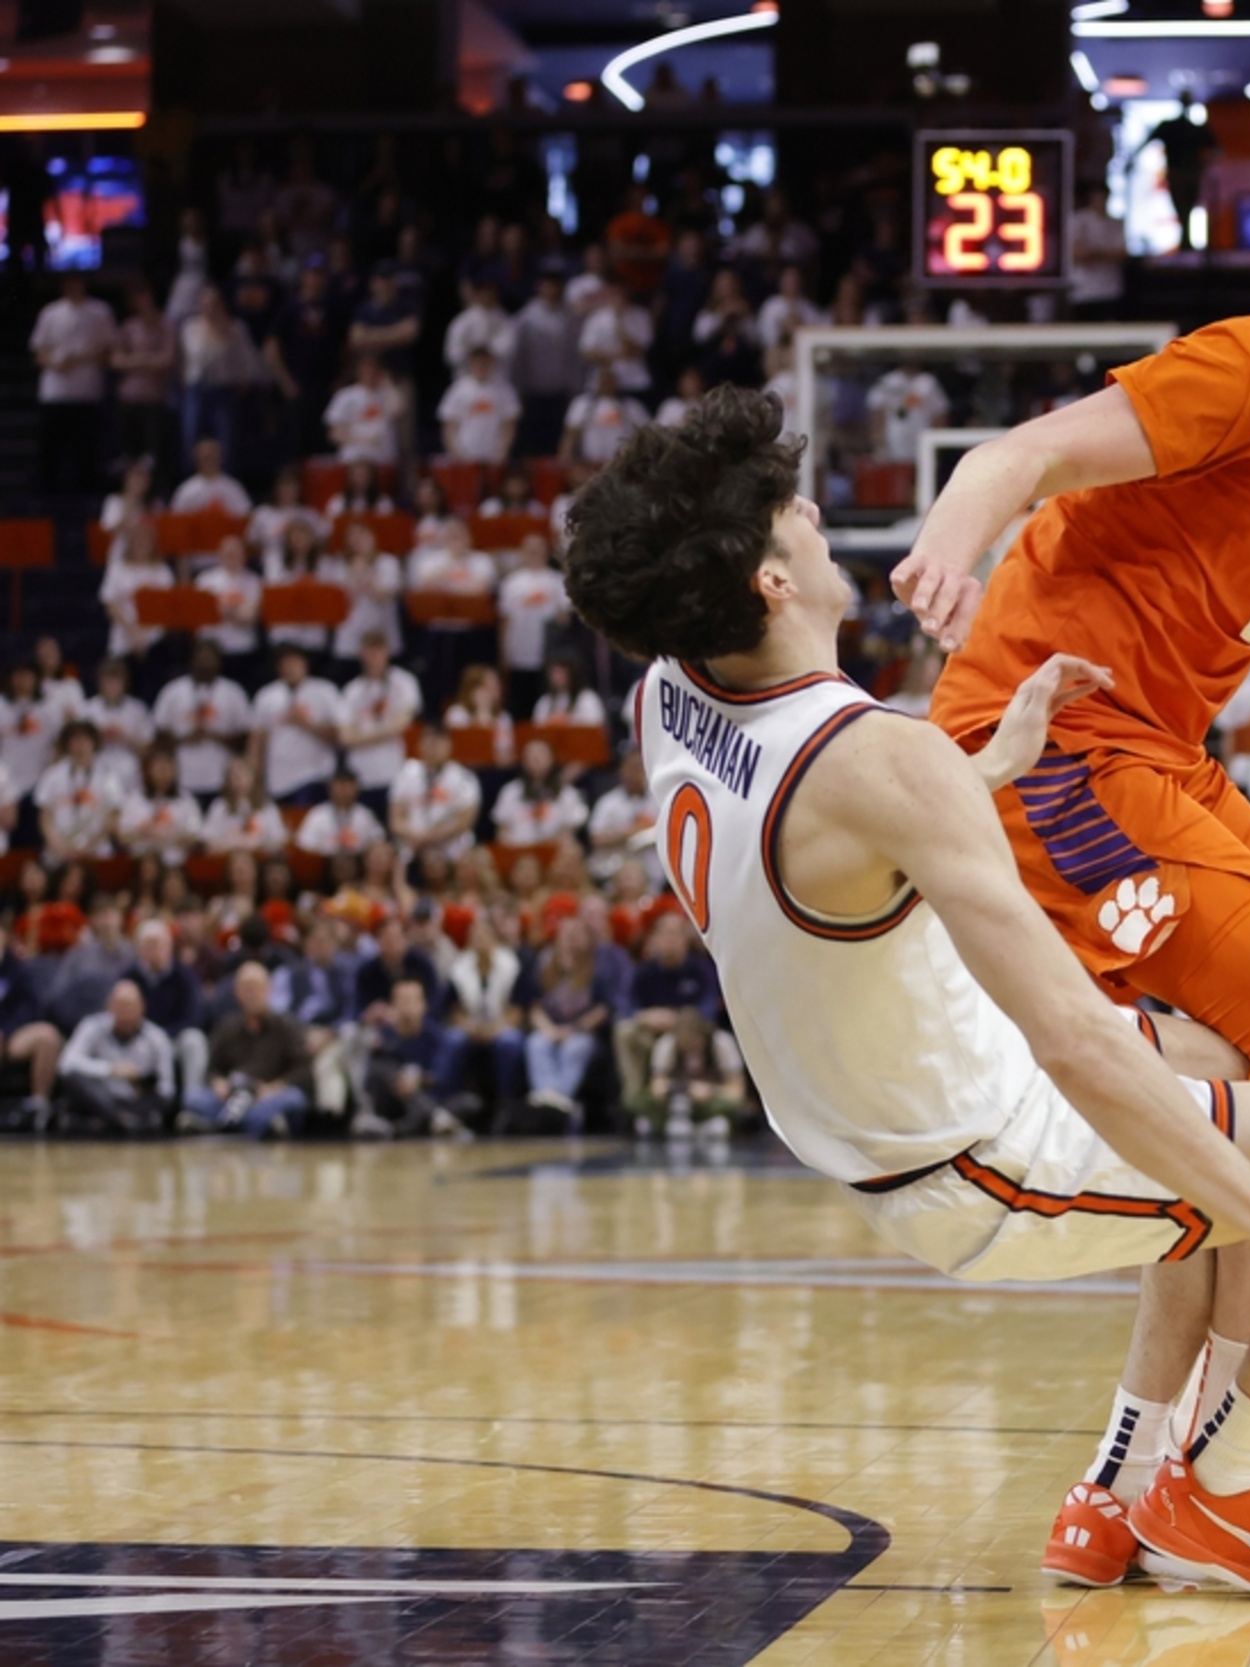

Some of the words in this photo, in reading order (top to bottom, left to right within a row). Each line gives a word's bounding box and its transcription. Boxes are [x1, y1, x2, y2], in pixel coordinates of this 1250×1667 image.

[932, 147, 1031, 195] 54.0
[944, 192, 1044, 272] 23
[659, 677, 762, 800] BUCHANAN
[667, 781, 712, 934] 0
